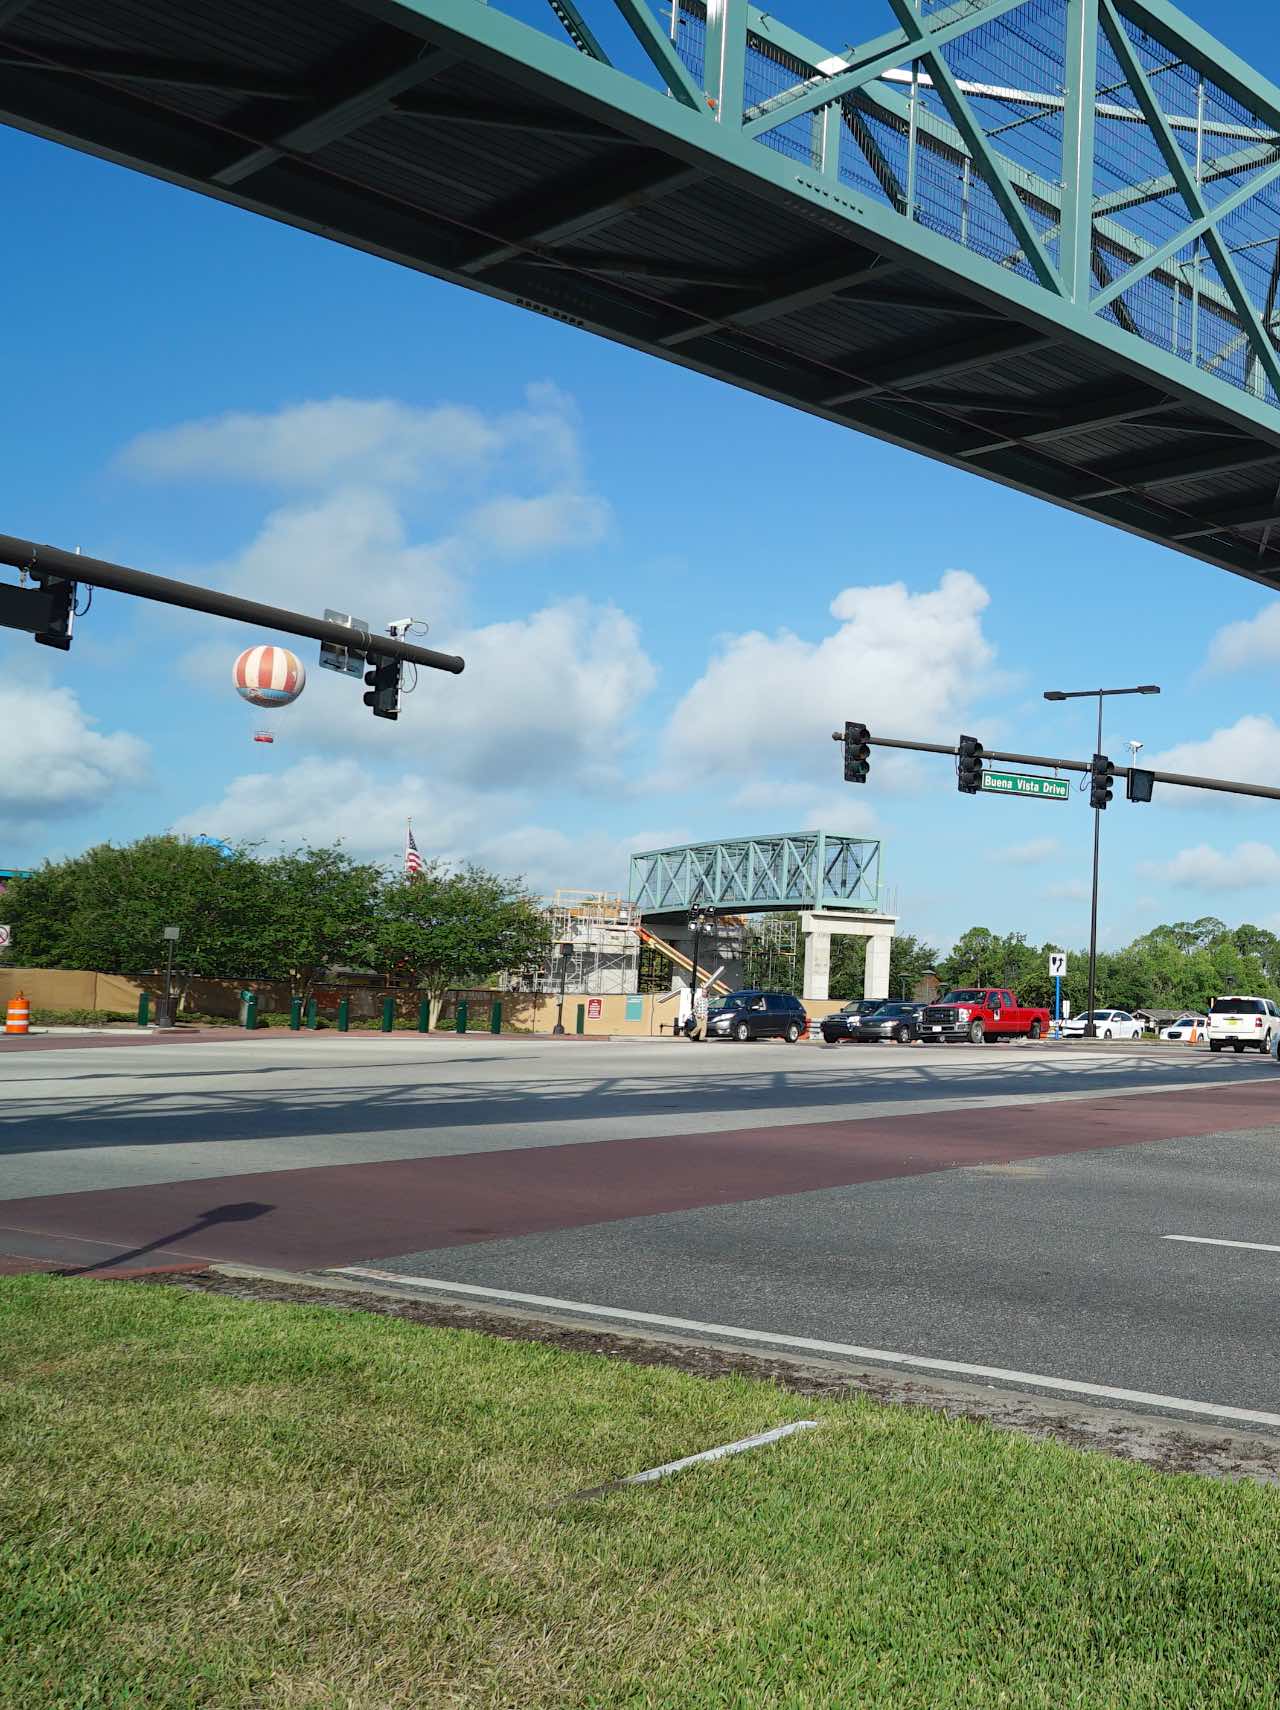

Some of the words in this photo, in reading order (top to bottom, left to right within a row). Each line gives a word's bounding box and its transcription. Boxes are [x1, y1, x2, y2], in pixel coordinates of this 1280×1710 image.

[984, 775, 1013, 788] Buena
[1017, 779, 1040, 792] Vista
[1042, 782, 1066, 795] Drive
